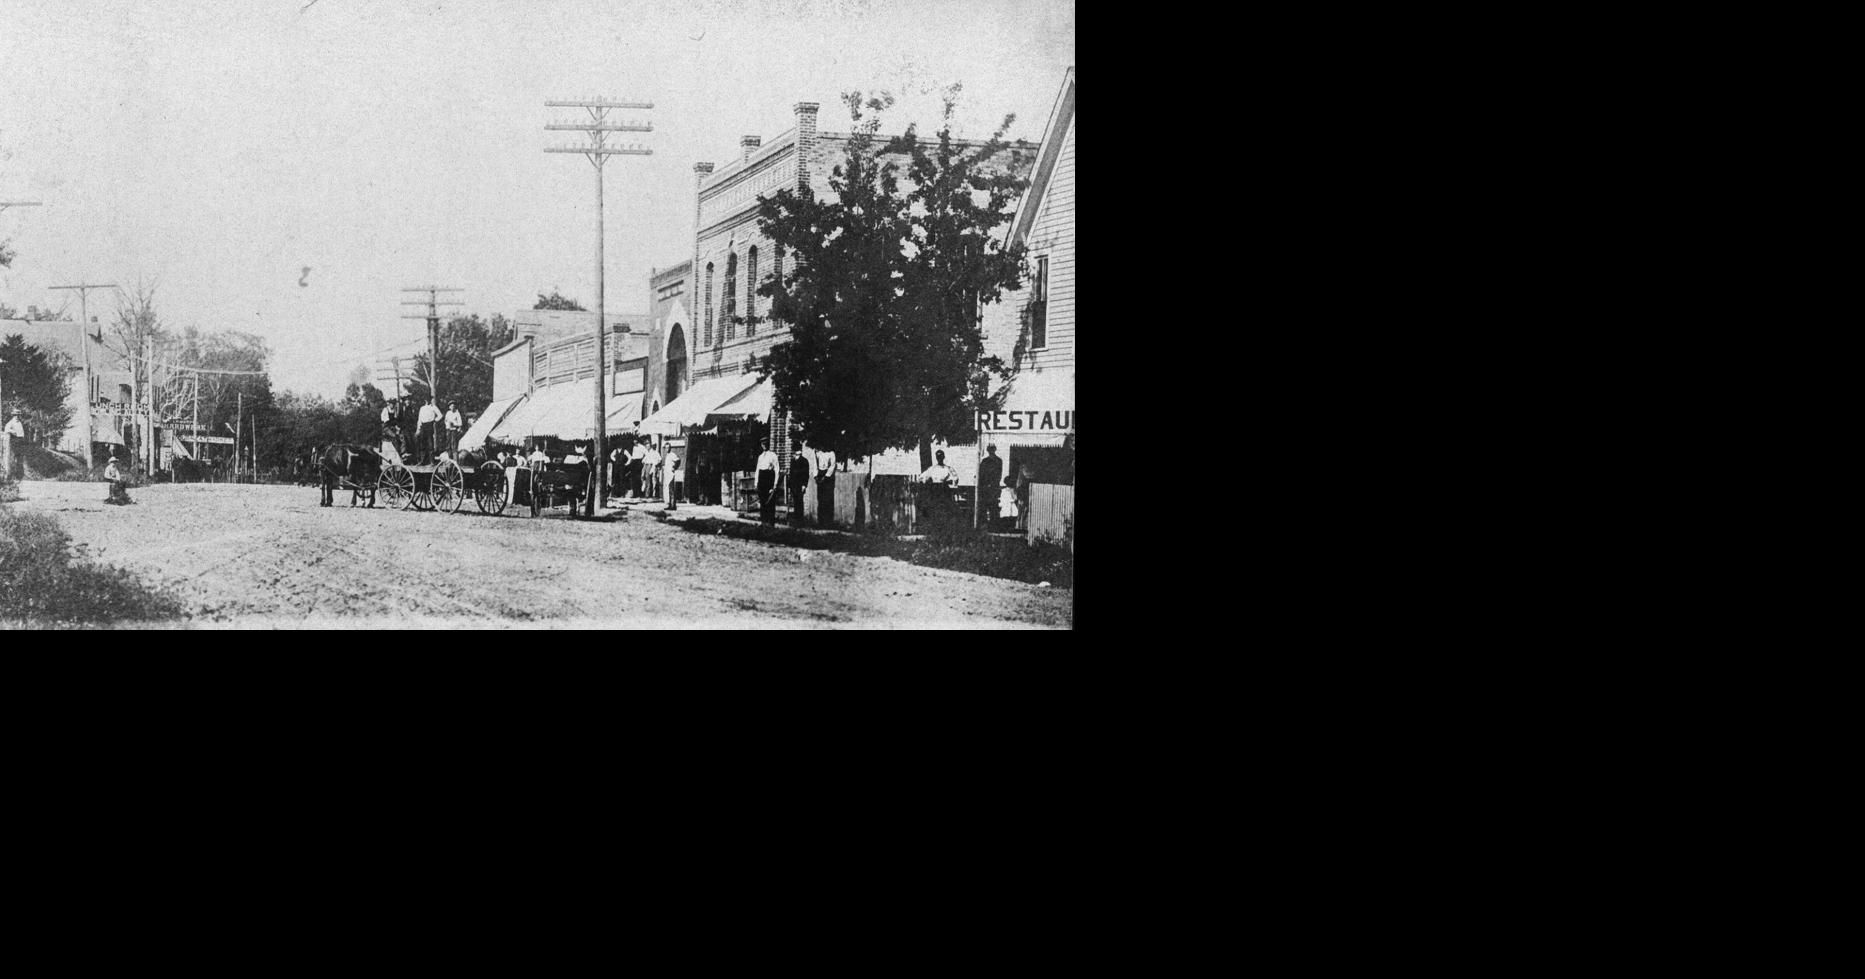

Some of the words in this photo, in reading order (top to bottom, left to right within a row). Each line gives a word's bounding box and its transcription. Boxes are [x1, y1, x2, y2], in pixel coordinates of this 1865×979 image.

[92, 402, 120, 410] UNCH
[124, 402, 149, 410] ROM
[978, 410, 1075, 430] RESTAU
